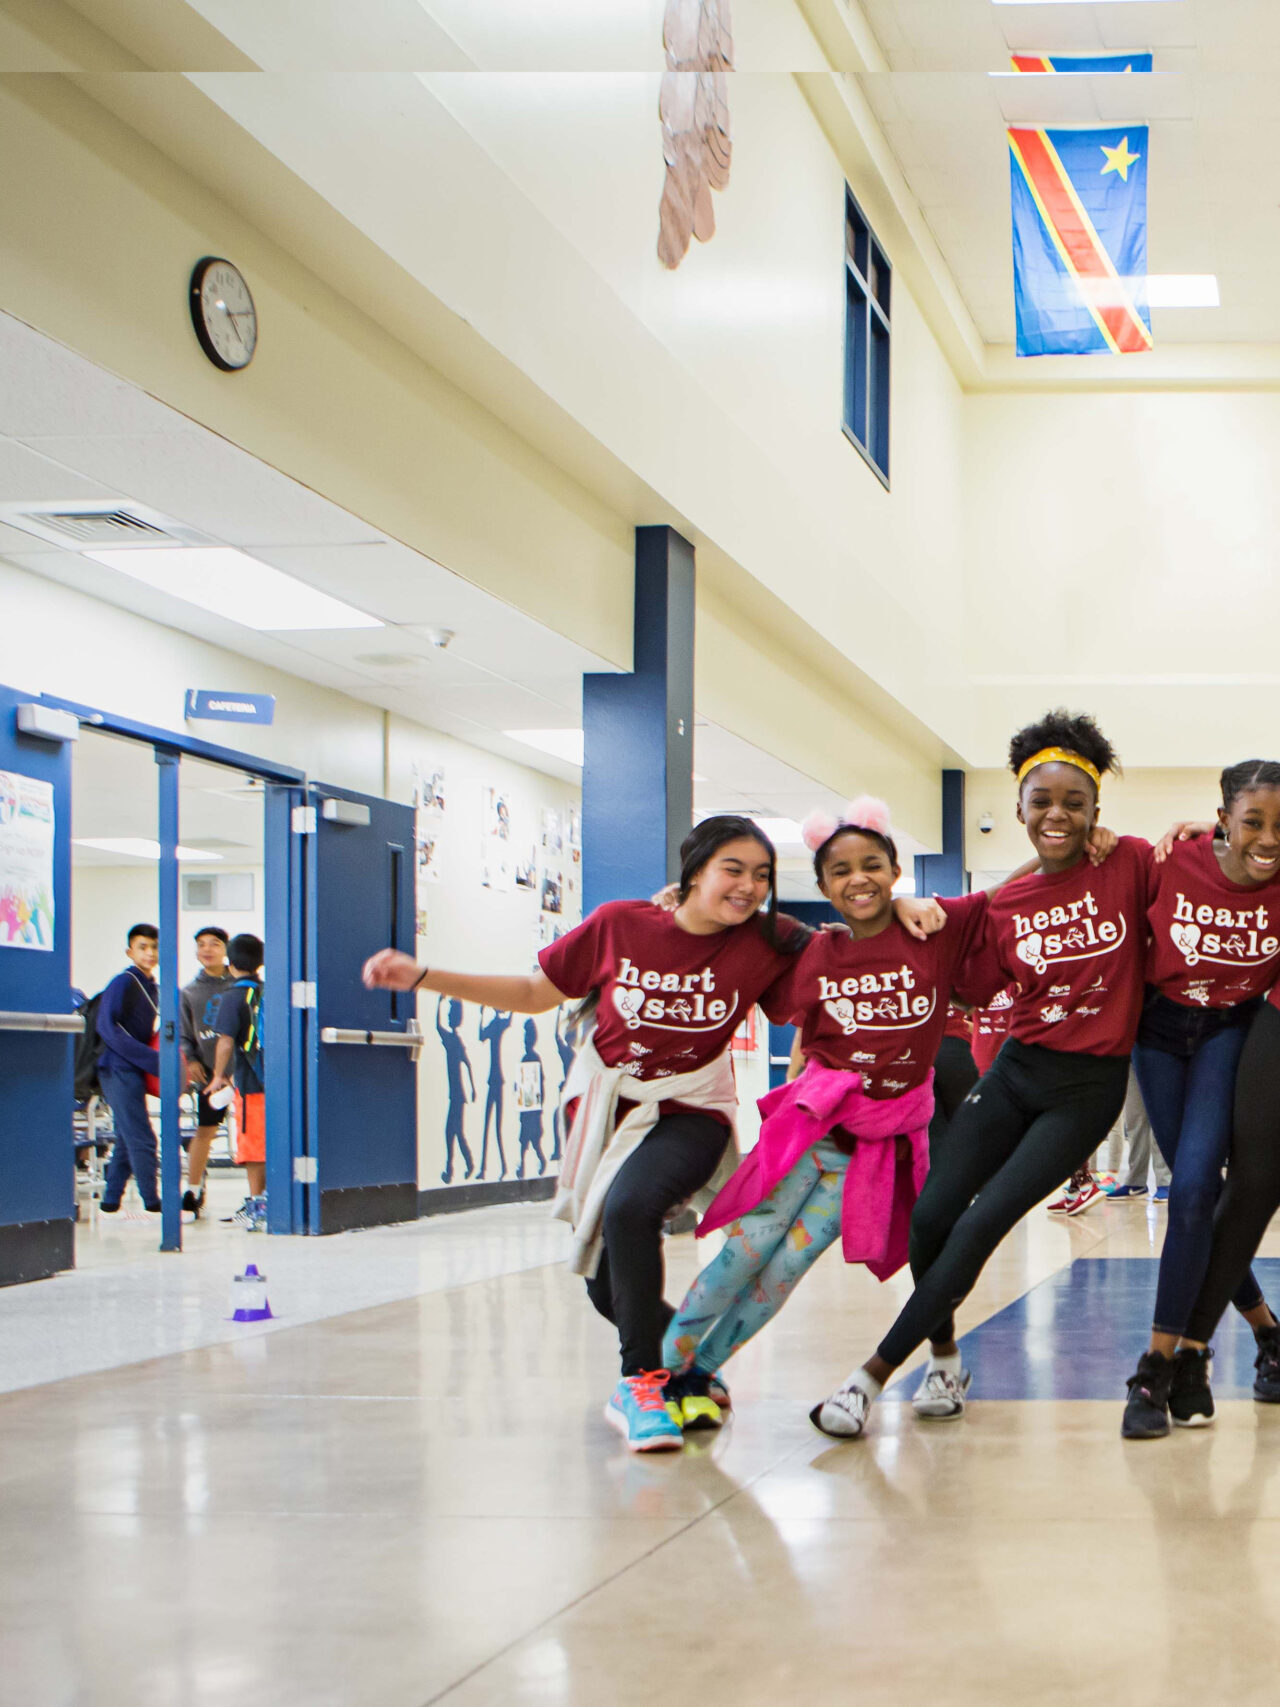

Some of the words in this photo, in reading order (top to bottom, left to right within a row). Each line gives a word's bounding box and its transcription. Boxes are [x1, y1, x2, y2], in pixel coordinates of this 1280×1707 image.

[1012, 891, 1098, 938] heart
[1173, 892, 1268, 930] heart
[615, 957, 715, 992] heart
[818, 965, 915, 1000] heart
